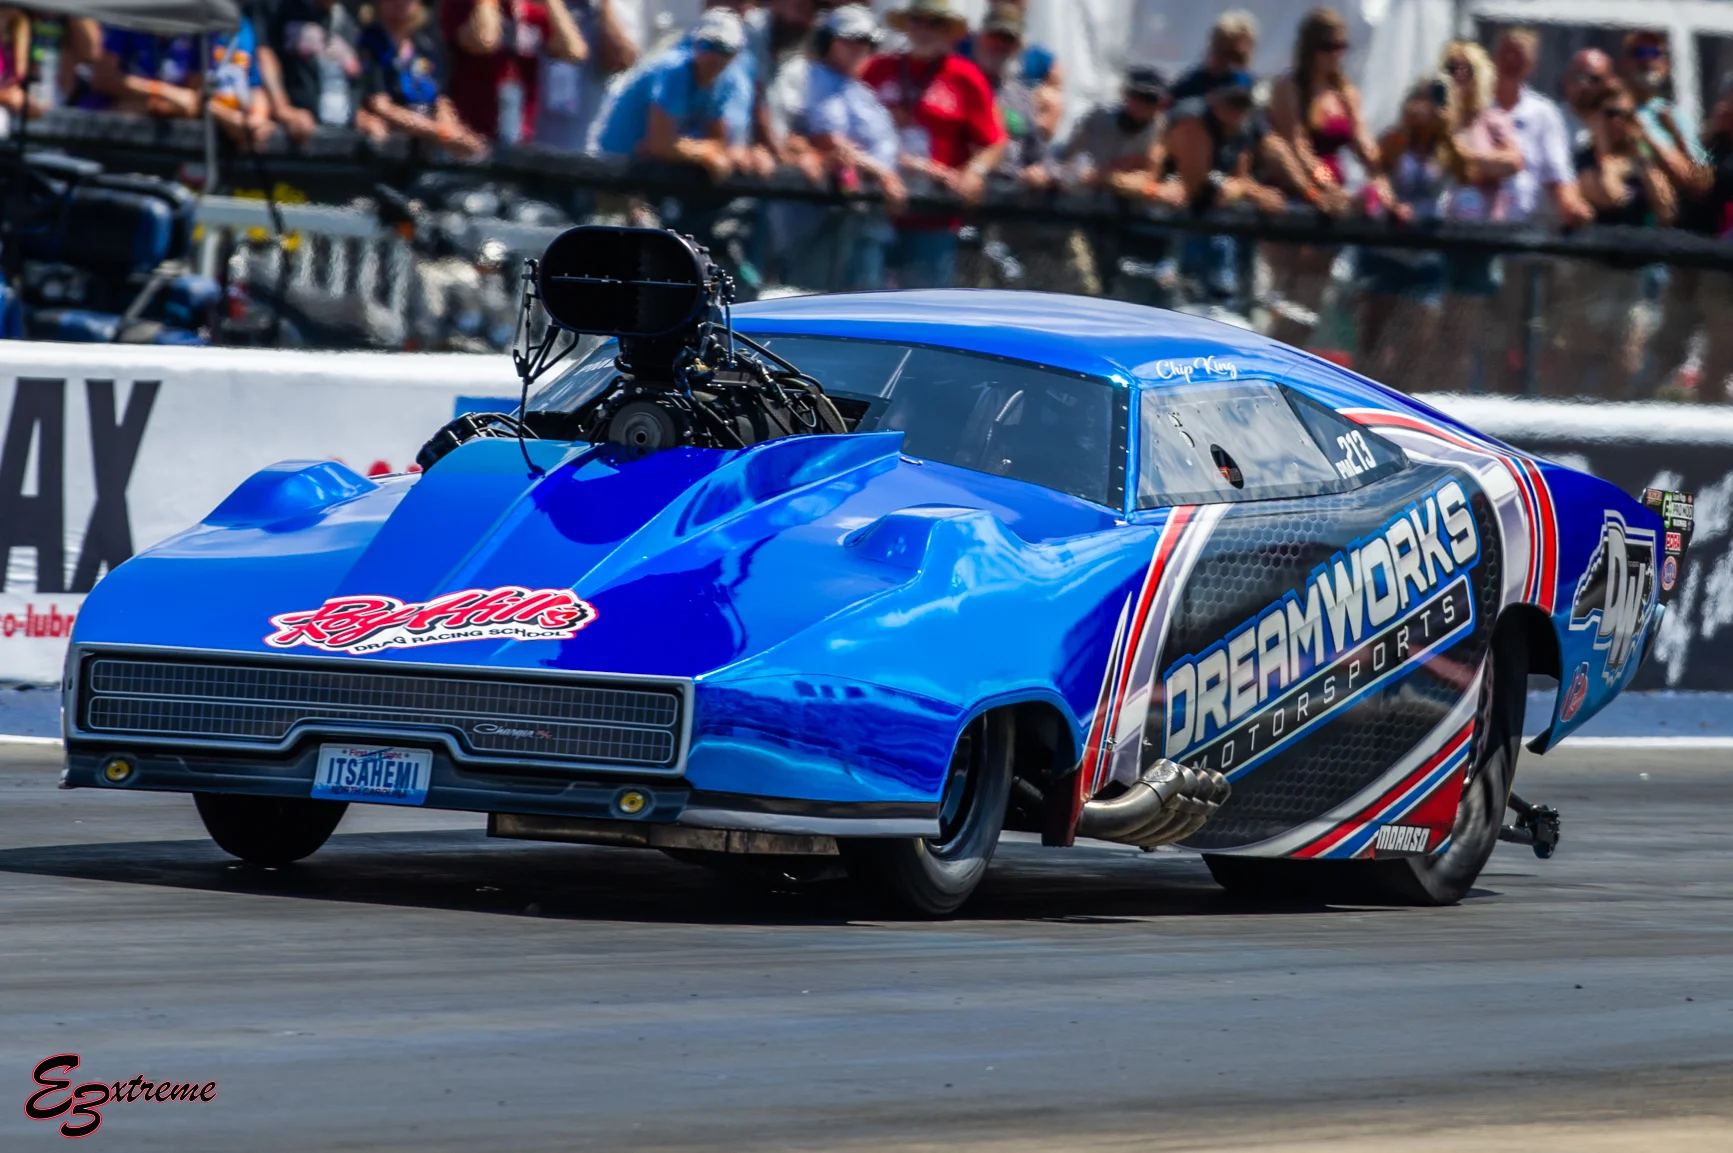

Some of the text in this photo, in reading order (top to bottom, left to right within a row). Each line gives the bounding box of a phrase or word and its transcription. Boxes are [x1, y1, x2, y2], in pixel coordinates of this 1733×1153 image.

[1156, 355, 1237, 384] Chip King
[275, 599, 417, 646] Roy
[1165, 480, 1478, 759] DREAMWORKS
[354, 628, 567, 651] DRAG RACING SCHOOL
[473, 723, 535, 739] Charger
[326, 757, 419, 789] ITSAHEMI
[1375, 825, 1431, 852] MOROSO
